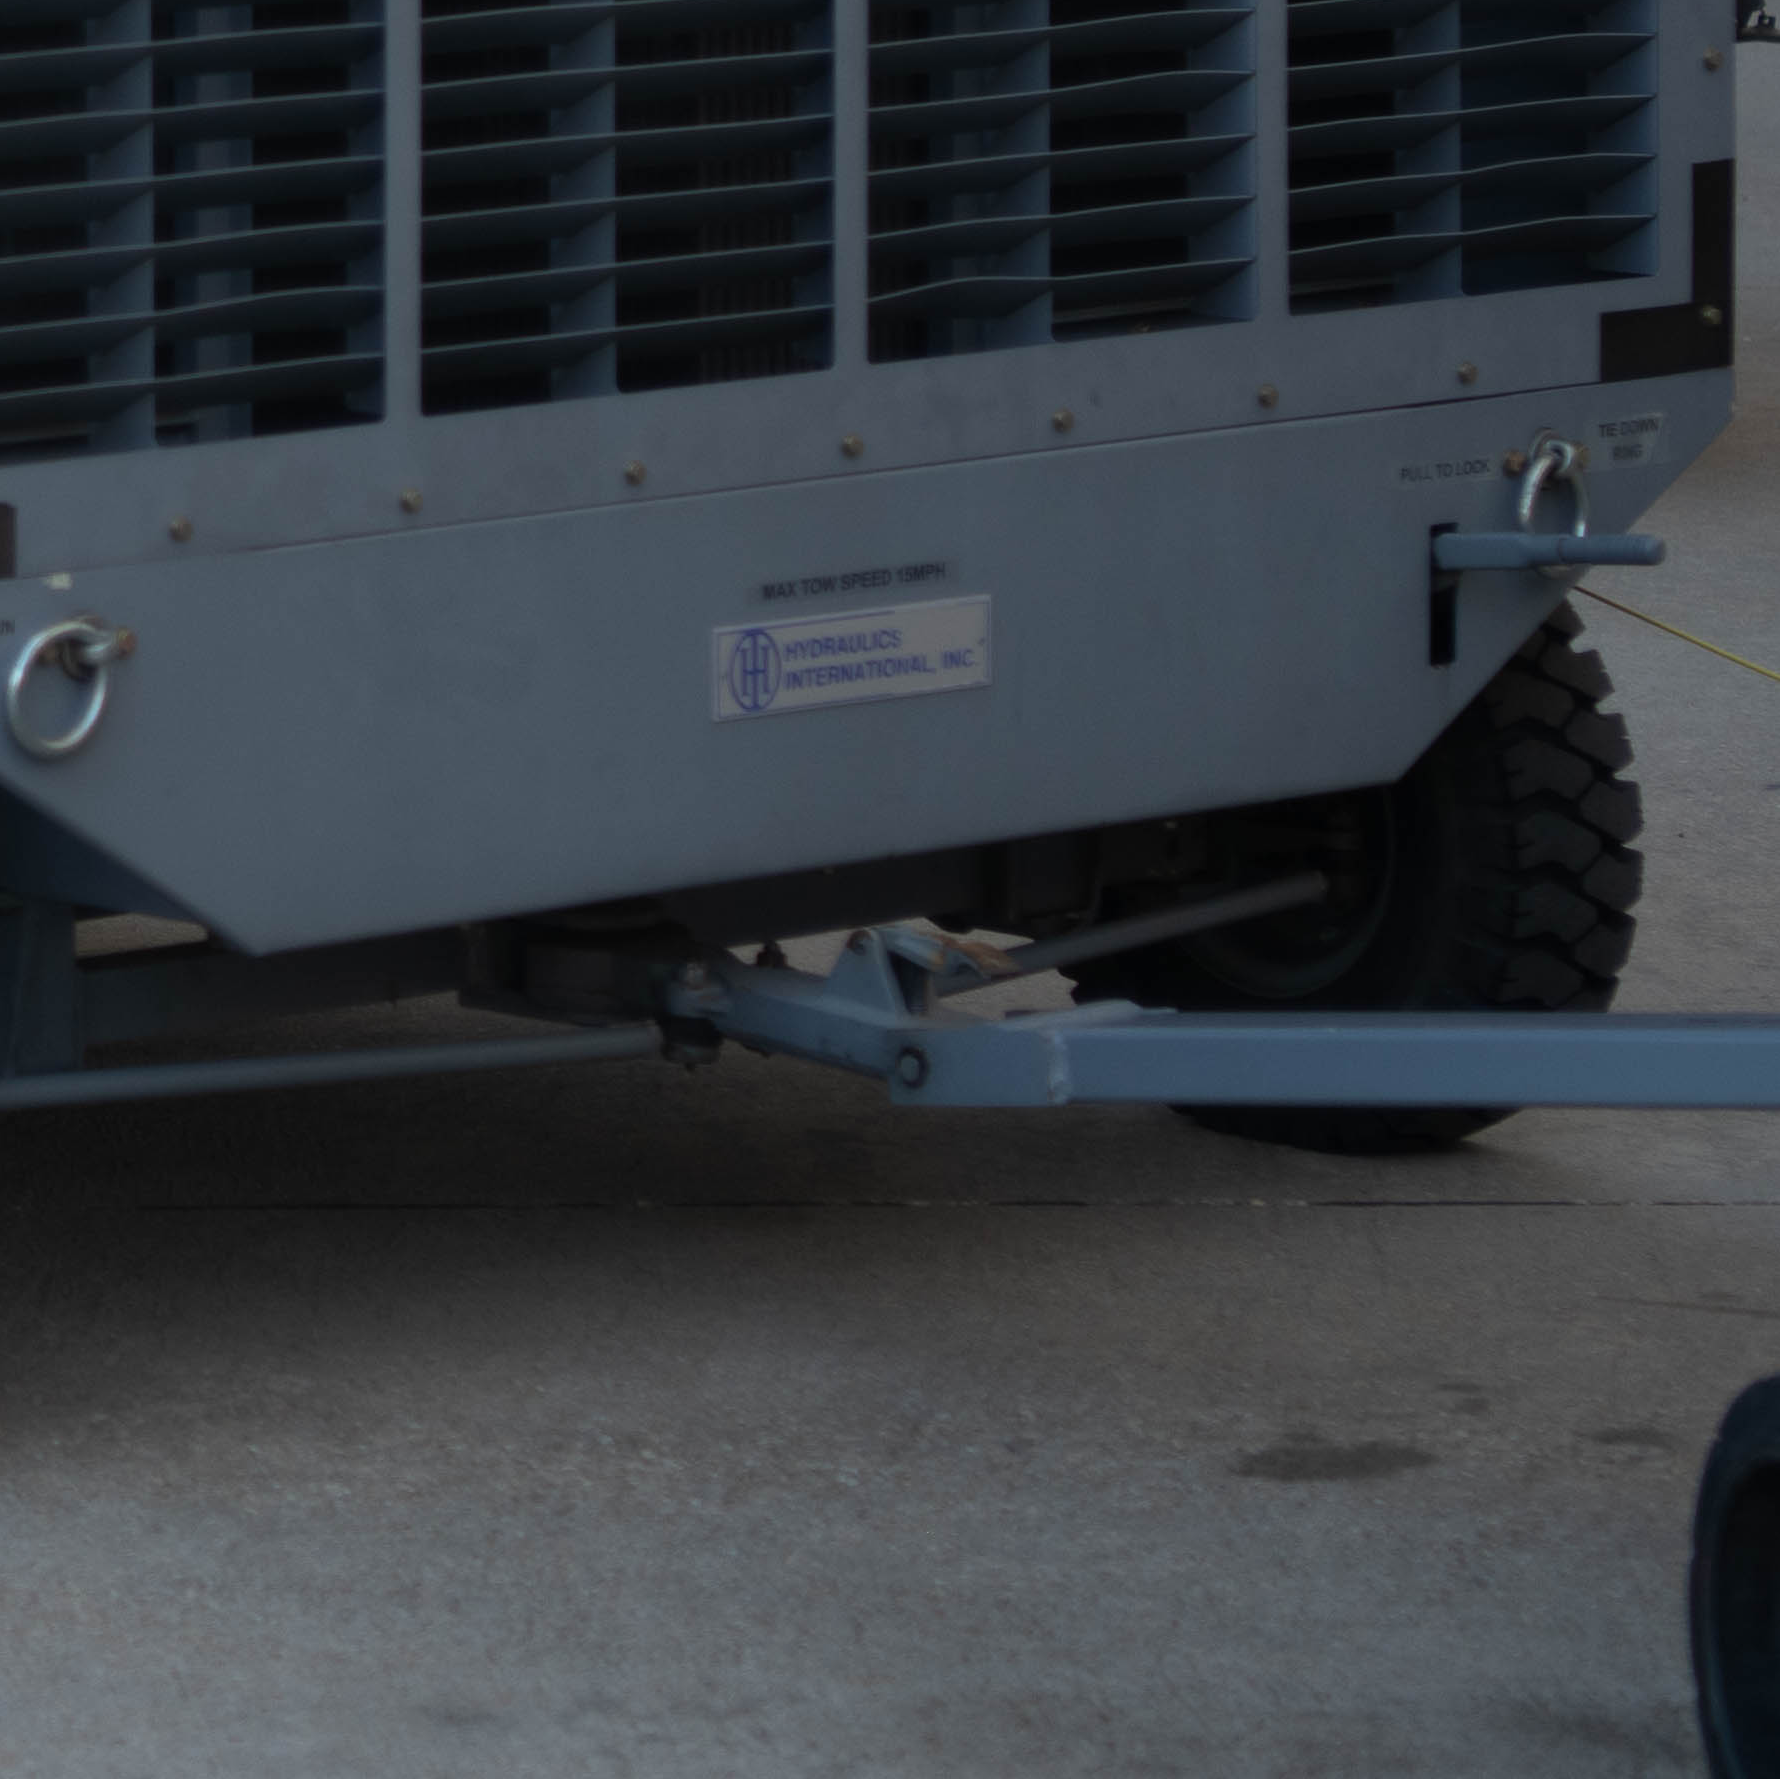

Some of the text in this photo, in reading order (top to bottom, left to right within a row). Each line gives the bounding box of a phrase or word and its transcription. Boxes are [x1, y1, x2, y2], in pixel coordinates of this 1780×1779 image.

[1598, 422, 1616, 438] TIE
[1400, 459, 1490, 484] PULL TO LOCK
[761, 562, 946, 601] MAX TOW SPEED 15MPH
[785, 629, 903, 663] HYDRAULICS
